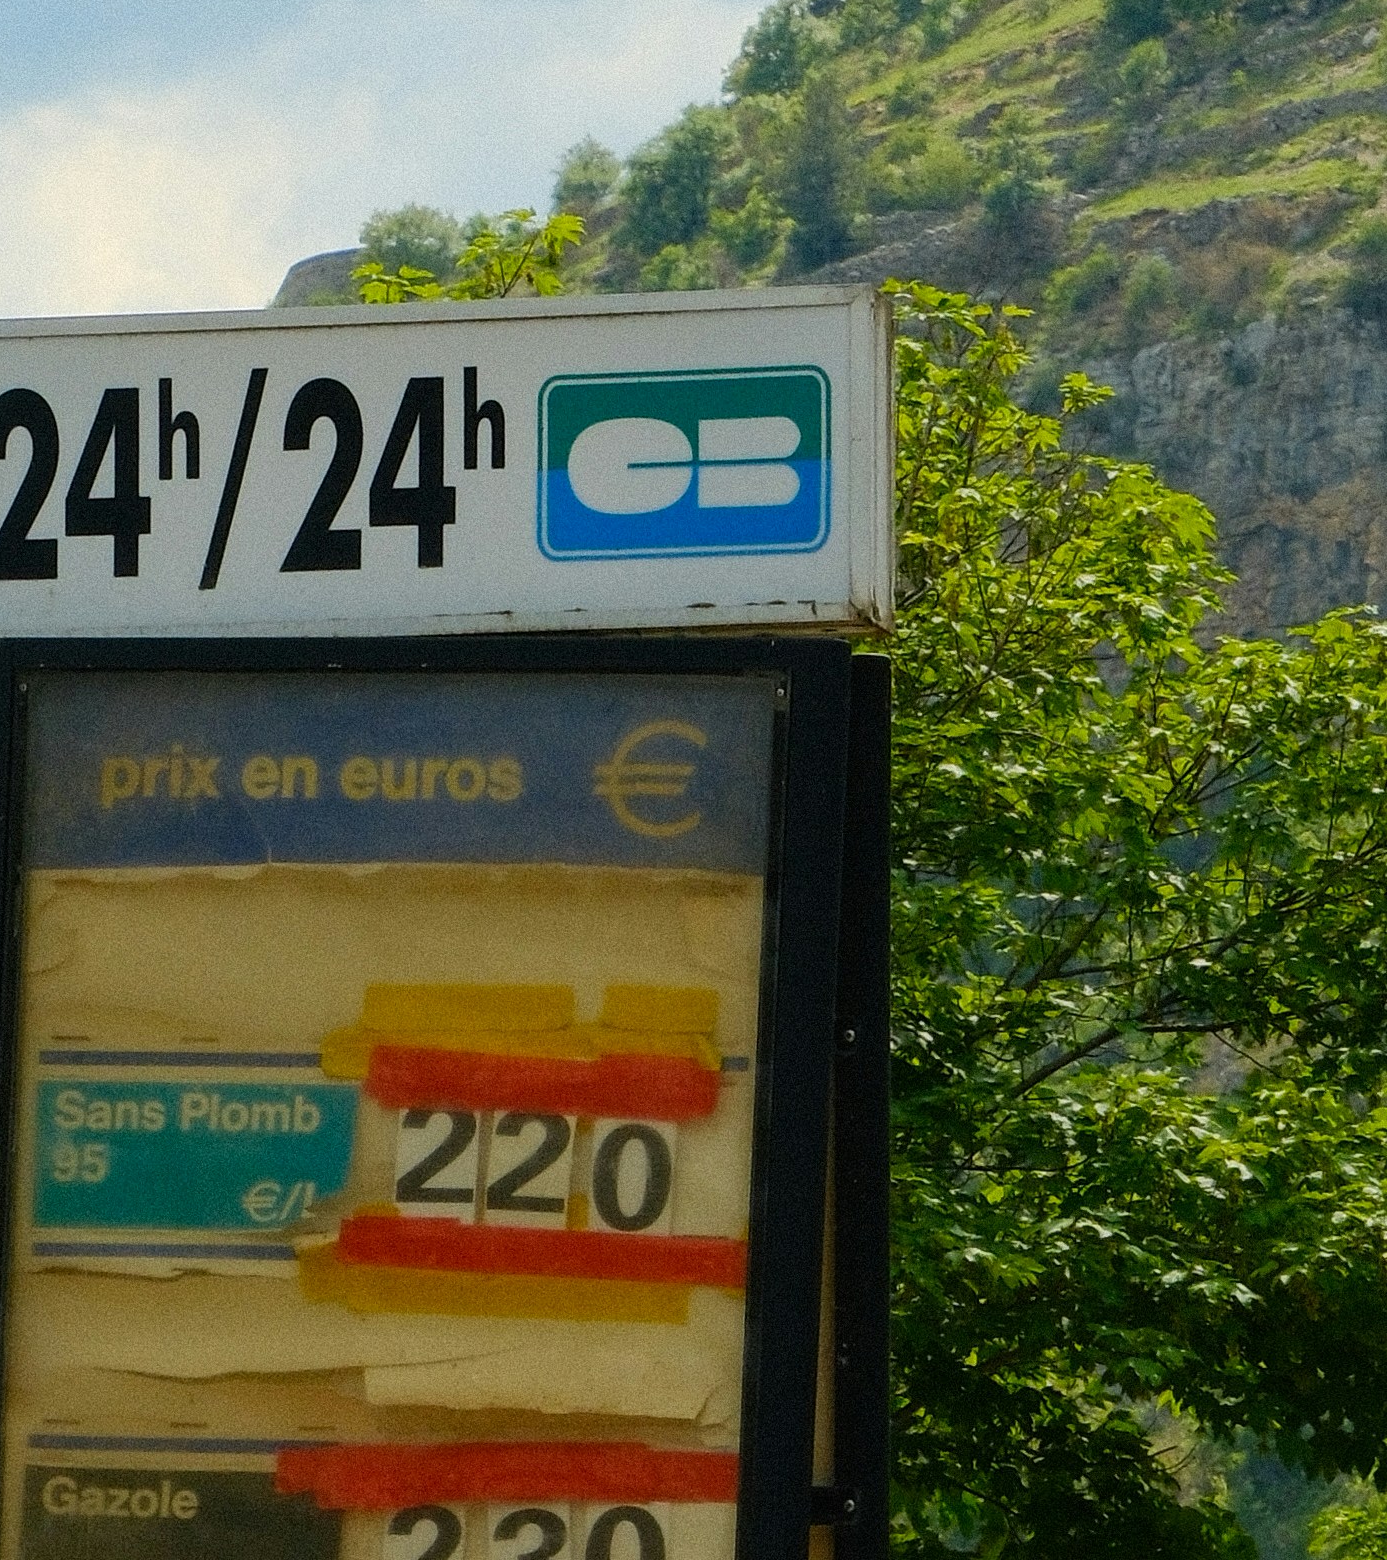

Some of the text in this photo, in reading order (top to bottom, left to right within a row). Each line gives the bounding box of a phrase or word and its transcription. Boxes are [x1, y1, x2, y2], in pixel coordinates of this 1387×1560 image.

[100, 746, 221, 809] prix
[241, 753, 318, 799] en
[339, 754, 525, 801] euros
[53, 1089, 322, 1133] Sans Plomb
[50, 1142, 108, 1183] 95
[395, 1108, 674, 1232] 220
[42, 1475, 200, 1519] Gazole
